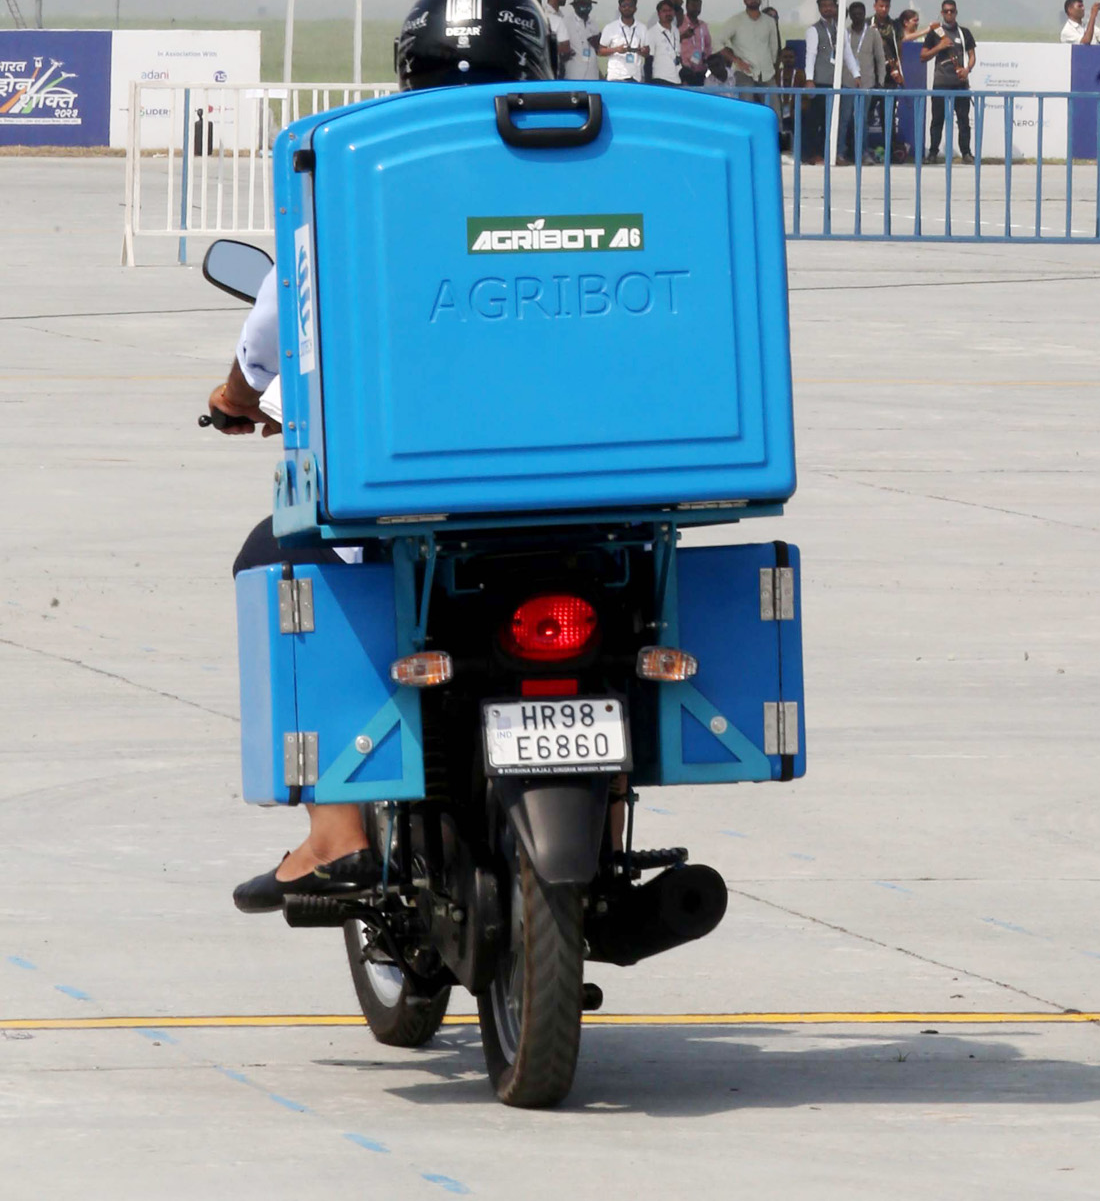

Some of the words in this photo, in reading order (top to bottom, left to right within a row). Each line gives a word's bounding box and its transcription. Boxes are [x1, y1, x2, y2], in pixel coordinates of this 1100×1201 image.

[497, 10, 536, 31] Real
[445, 26, 481, 37] DEZAR
[141, 70, 169, 80] adani
[471, 228, 606, 250] AGRIBOT
[608, 228, 642, 248] A6
[428, 269, 692, 324] AGRIBOT
[521, 703, 595, 731] HR98
[496, 731, 513, 739] IND
[516, 733, 609, 761] E6860
